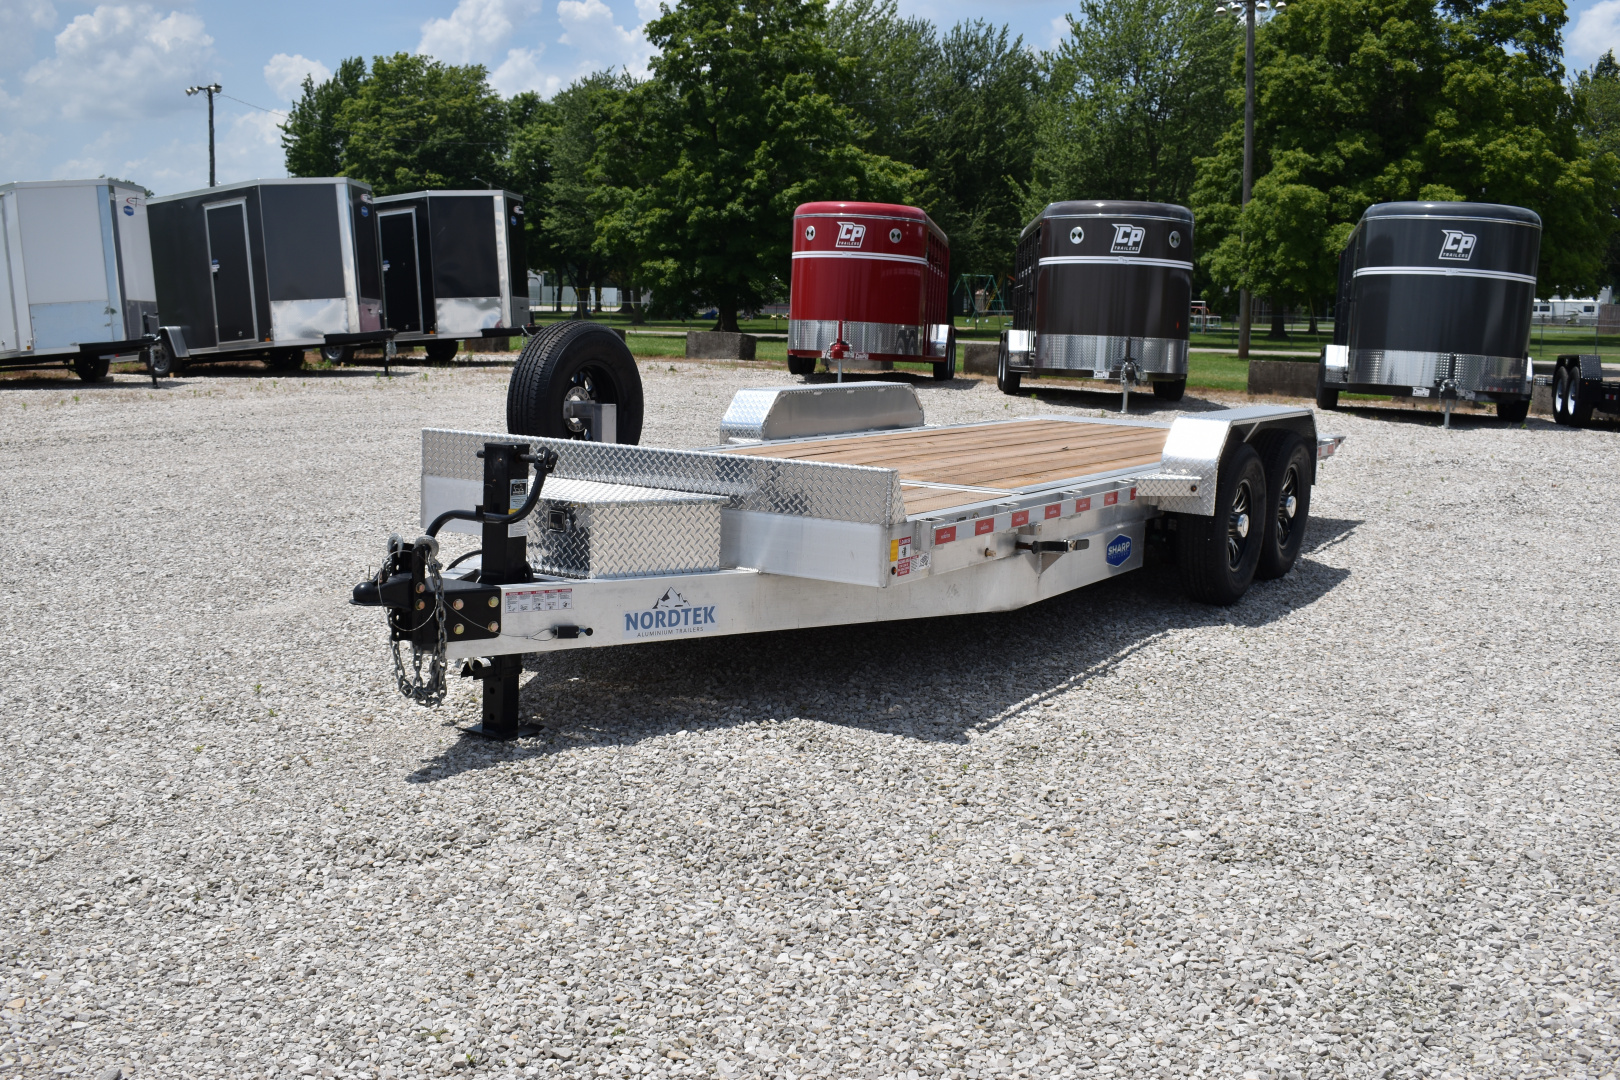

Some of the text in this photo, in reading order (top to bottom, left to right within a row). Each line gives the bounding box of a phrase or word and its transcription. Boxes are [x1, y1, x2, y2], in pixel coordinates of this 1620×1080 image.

[840, 224, 864, 242] CP
[1115, 226, 1143, 246] CP
[1445, 232, 1474, 253] CP
[1108, 541, 1130, 556] SHARP
[624, 605, 716, 631] NORDTEK
[637, 626, 704, 638] ALUMINIUM TRAILERS
